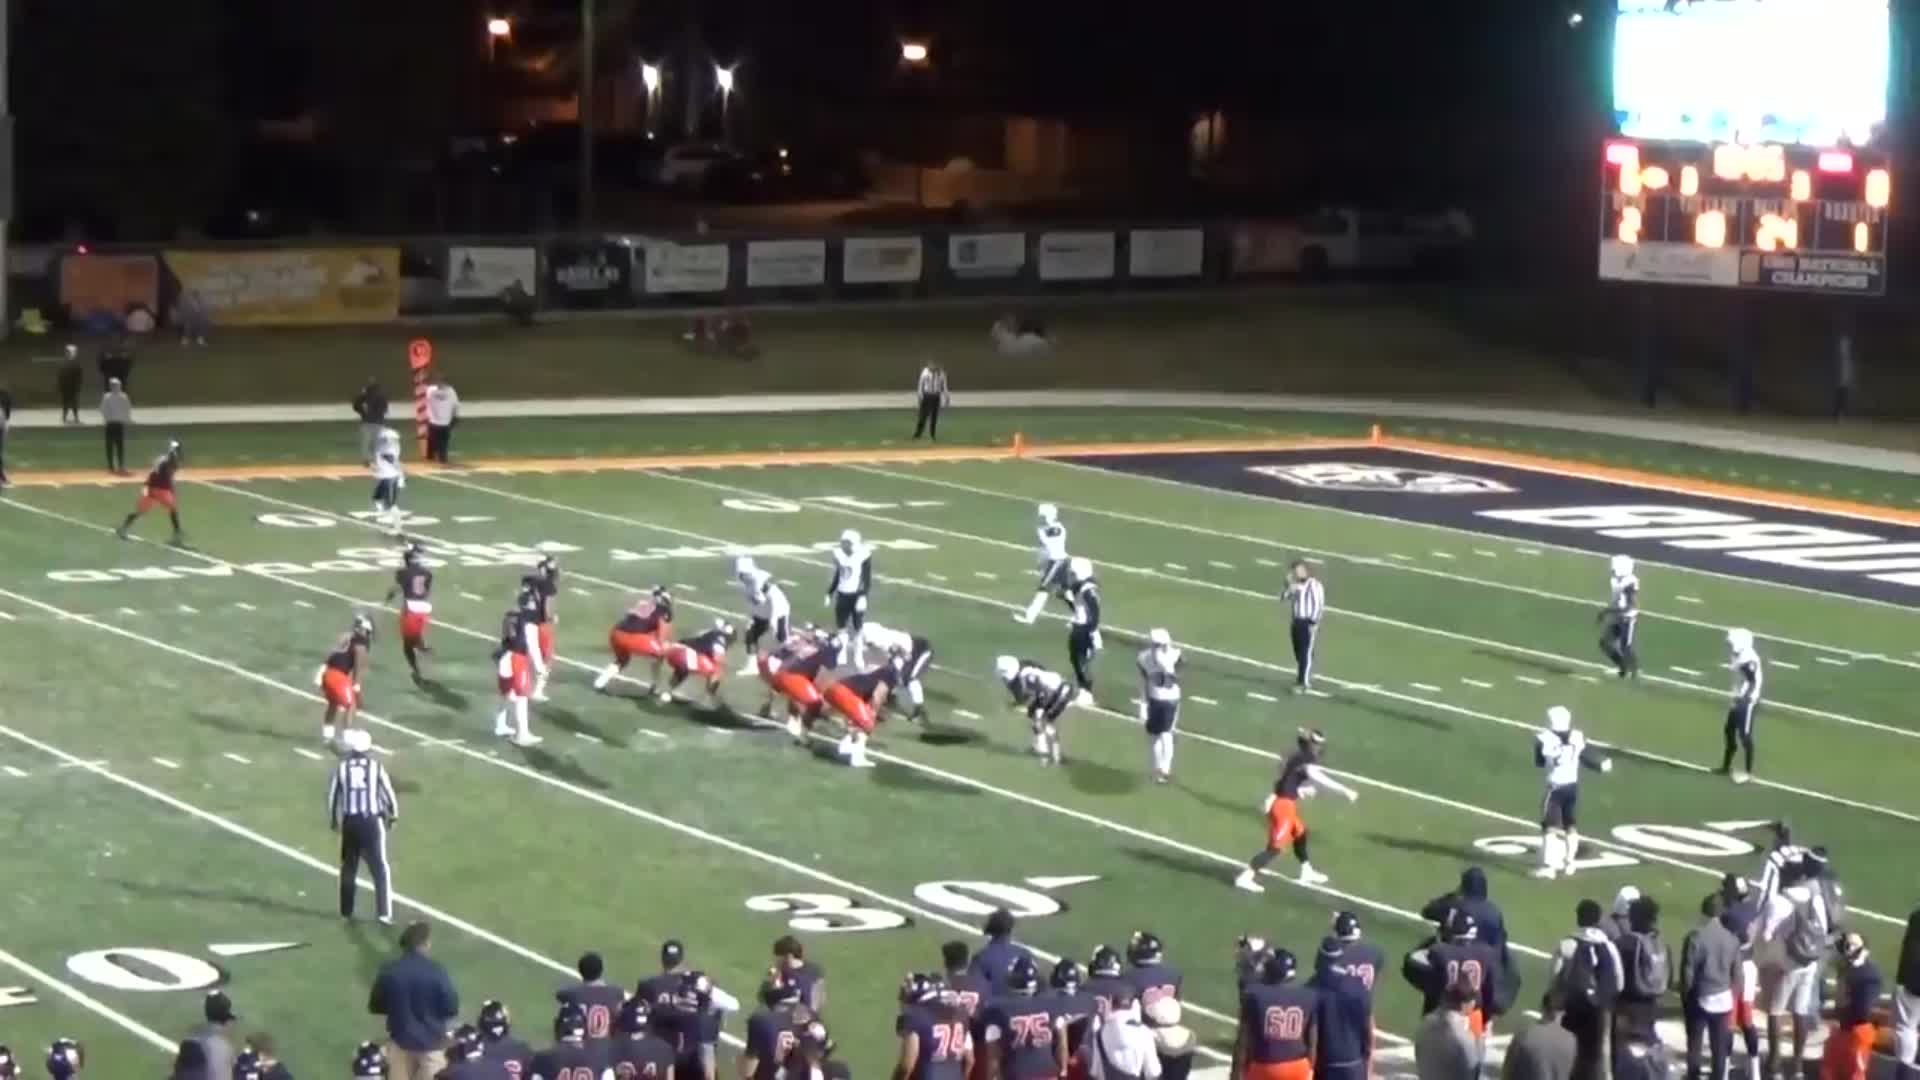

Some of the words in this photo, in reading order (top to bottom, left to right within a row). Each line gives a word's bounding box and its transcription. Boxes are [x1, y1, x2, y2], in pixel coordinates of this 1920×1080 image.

[1770, 270, 1869, 289] CHAMPIONS
[350, 765, 368, 789] R
[745, 879, 1060, 931] 30
[932, 1022, 965, 1062] 74
[1009, 1011, 1053, 1049] 75
